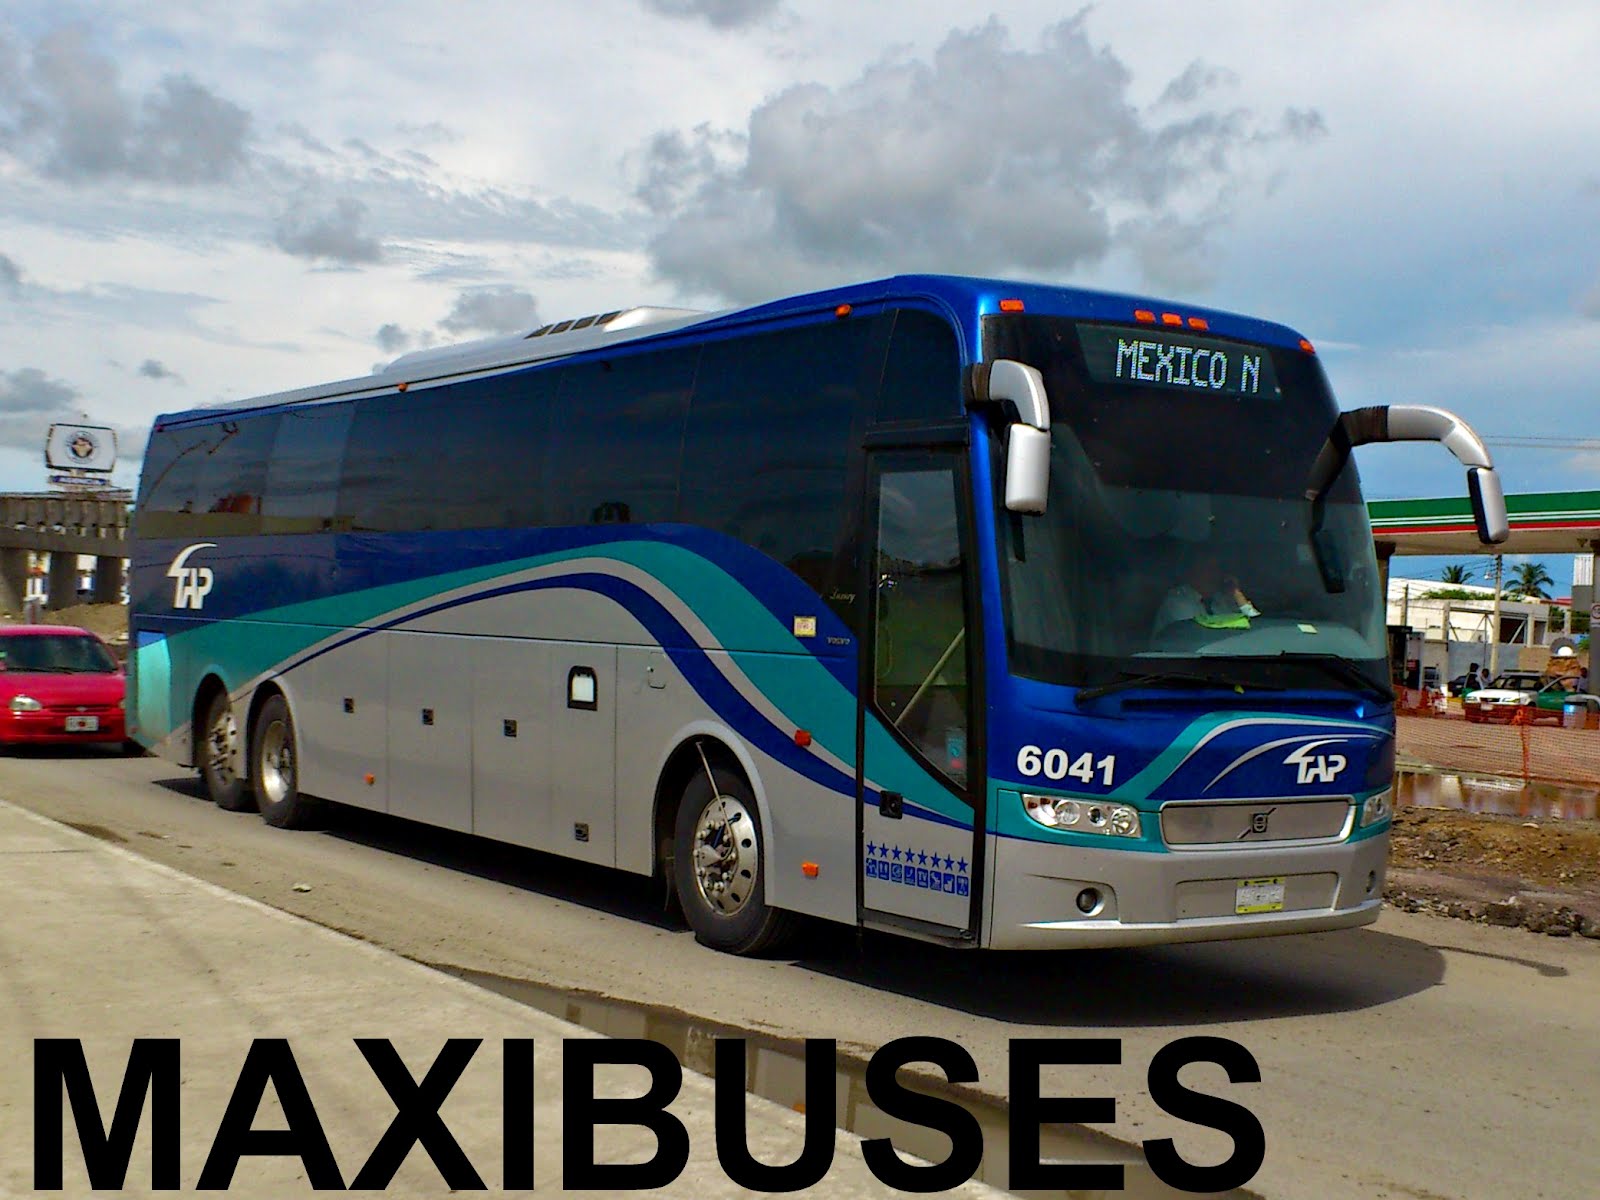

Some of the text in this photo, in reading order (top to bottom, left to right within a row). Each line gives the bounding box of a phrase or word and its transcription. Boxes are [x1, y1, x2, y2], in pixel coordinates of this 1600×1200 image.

[1115, 338, 1261, 394] MEXICO N
[166, 542, 218, 610] TAP
[1016, 745, 1117, 786] 6041
[1283, 738, 1348, 785] TAP
